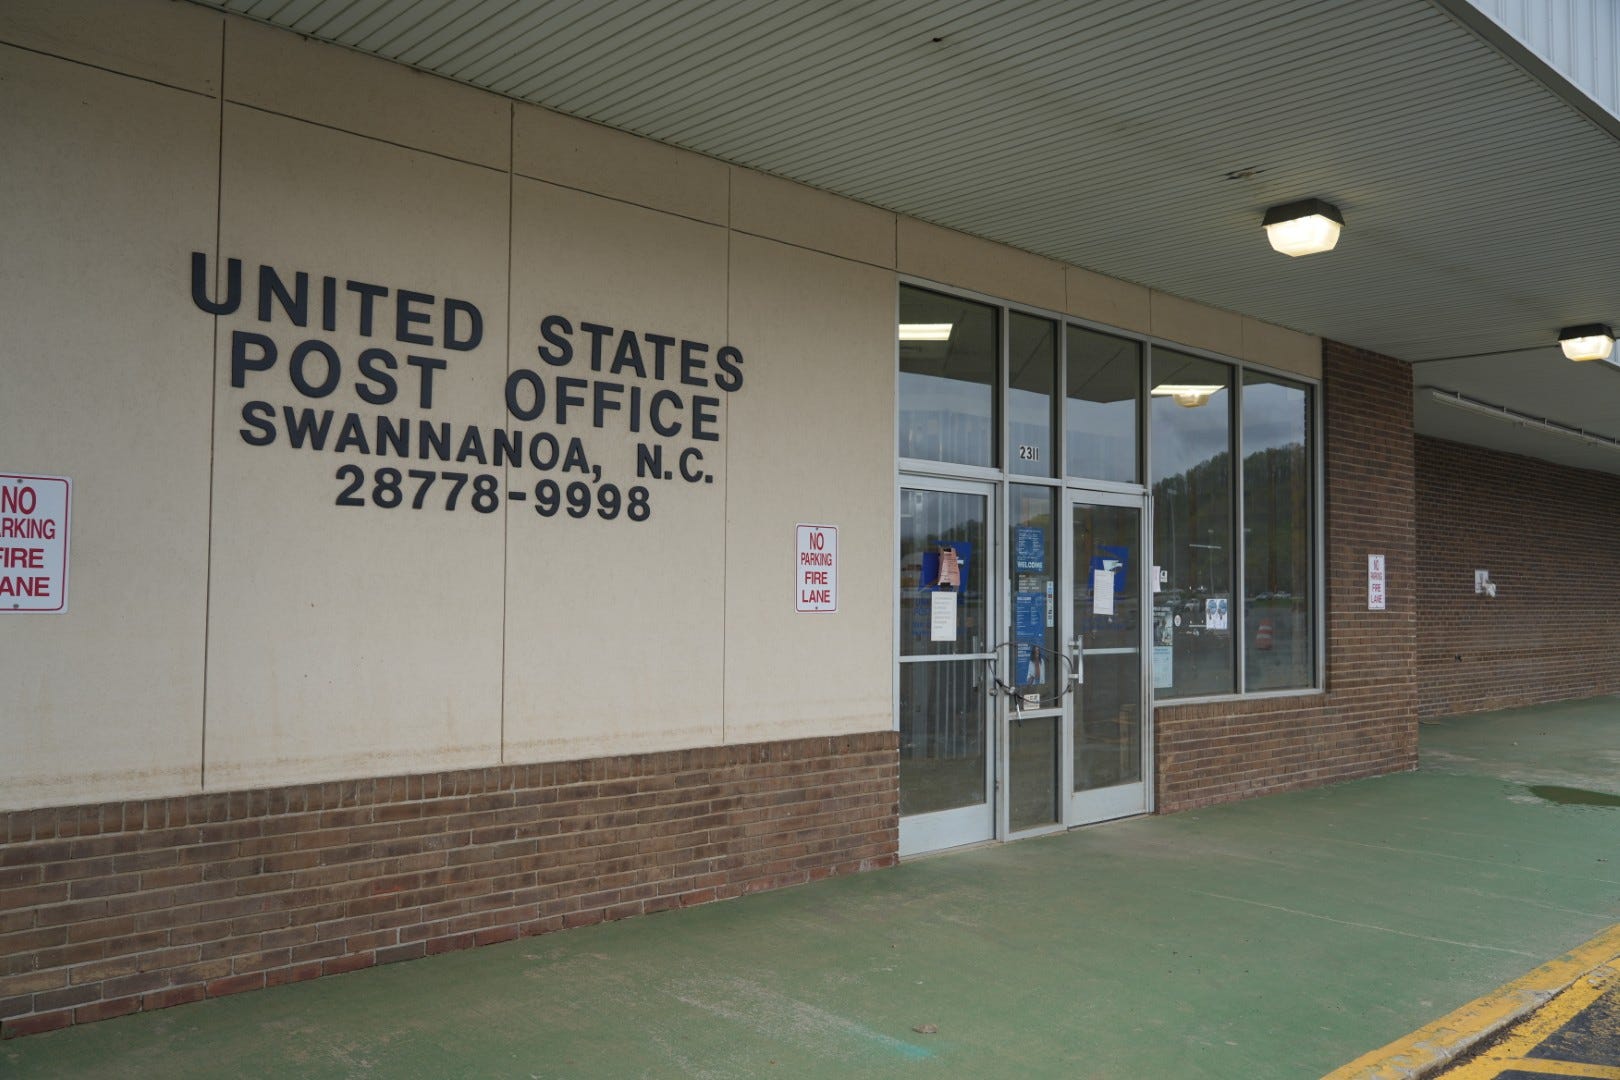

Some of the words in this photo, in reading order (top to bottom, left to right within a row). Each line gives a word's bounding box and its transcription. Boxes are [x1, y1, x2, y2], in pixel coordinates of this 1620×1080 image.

[191, 252, 484, 351] UNITED
[537, 315, 744, 392] STATES
[231, 330, 447, 409] POST
[504, 369, 720, 441] OFFICE
[239, 400, 602, 484] SWANNANOA,
[636, 442, 714, 484] N.C.
[1020, 446, 1039, 460] 2311
[1, 486, 37, 515] NO
[335, 463, 652, 522] 28778-9998
[0, 517, 56, 540] RKING
[809, 532, 824, 550] NO
[800, 552, 832, 566] PARKING
[1017, 561, 1043, 569] WELCOME
[0, 576, 50, 597] ANE
[804, 571, 828, 585] FIRE
[801, 589, 831, 603] LANE
[1372, 584, 1382, 593] FIRE
[1371, 595, 1383, 604] LANE
